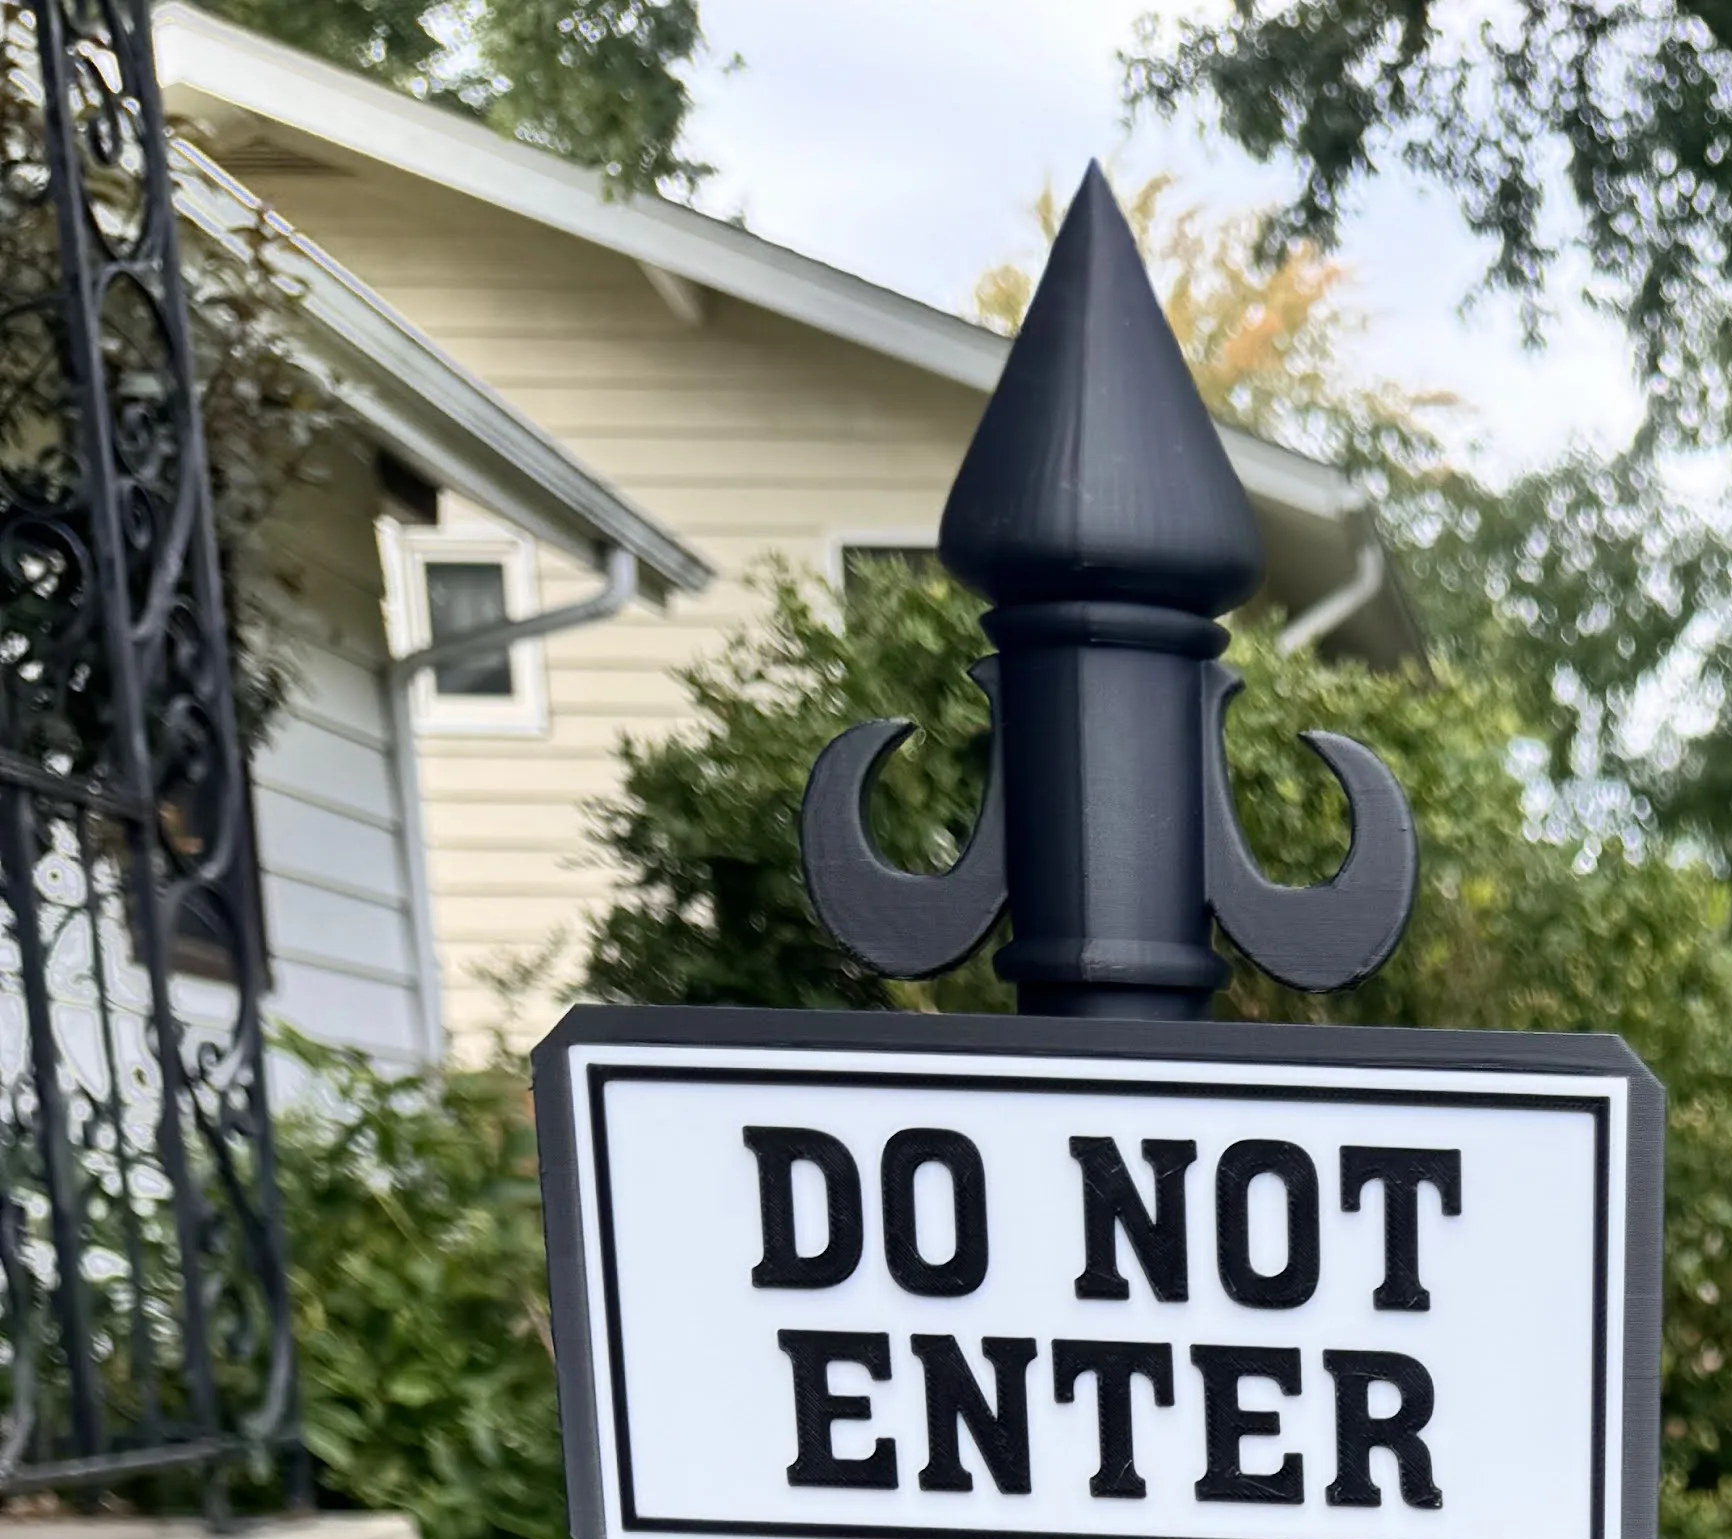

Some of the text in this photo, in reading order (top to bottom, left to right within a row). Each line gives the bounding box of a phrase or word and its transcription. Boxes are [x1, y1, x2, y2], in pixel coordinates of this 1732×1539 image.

[743, 1126, 1461, 1312] DO NOT
[778, 1329, 1442, 1509] ENTER
